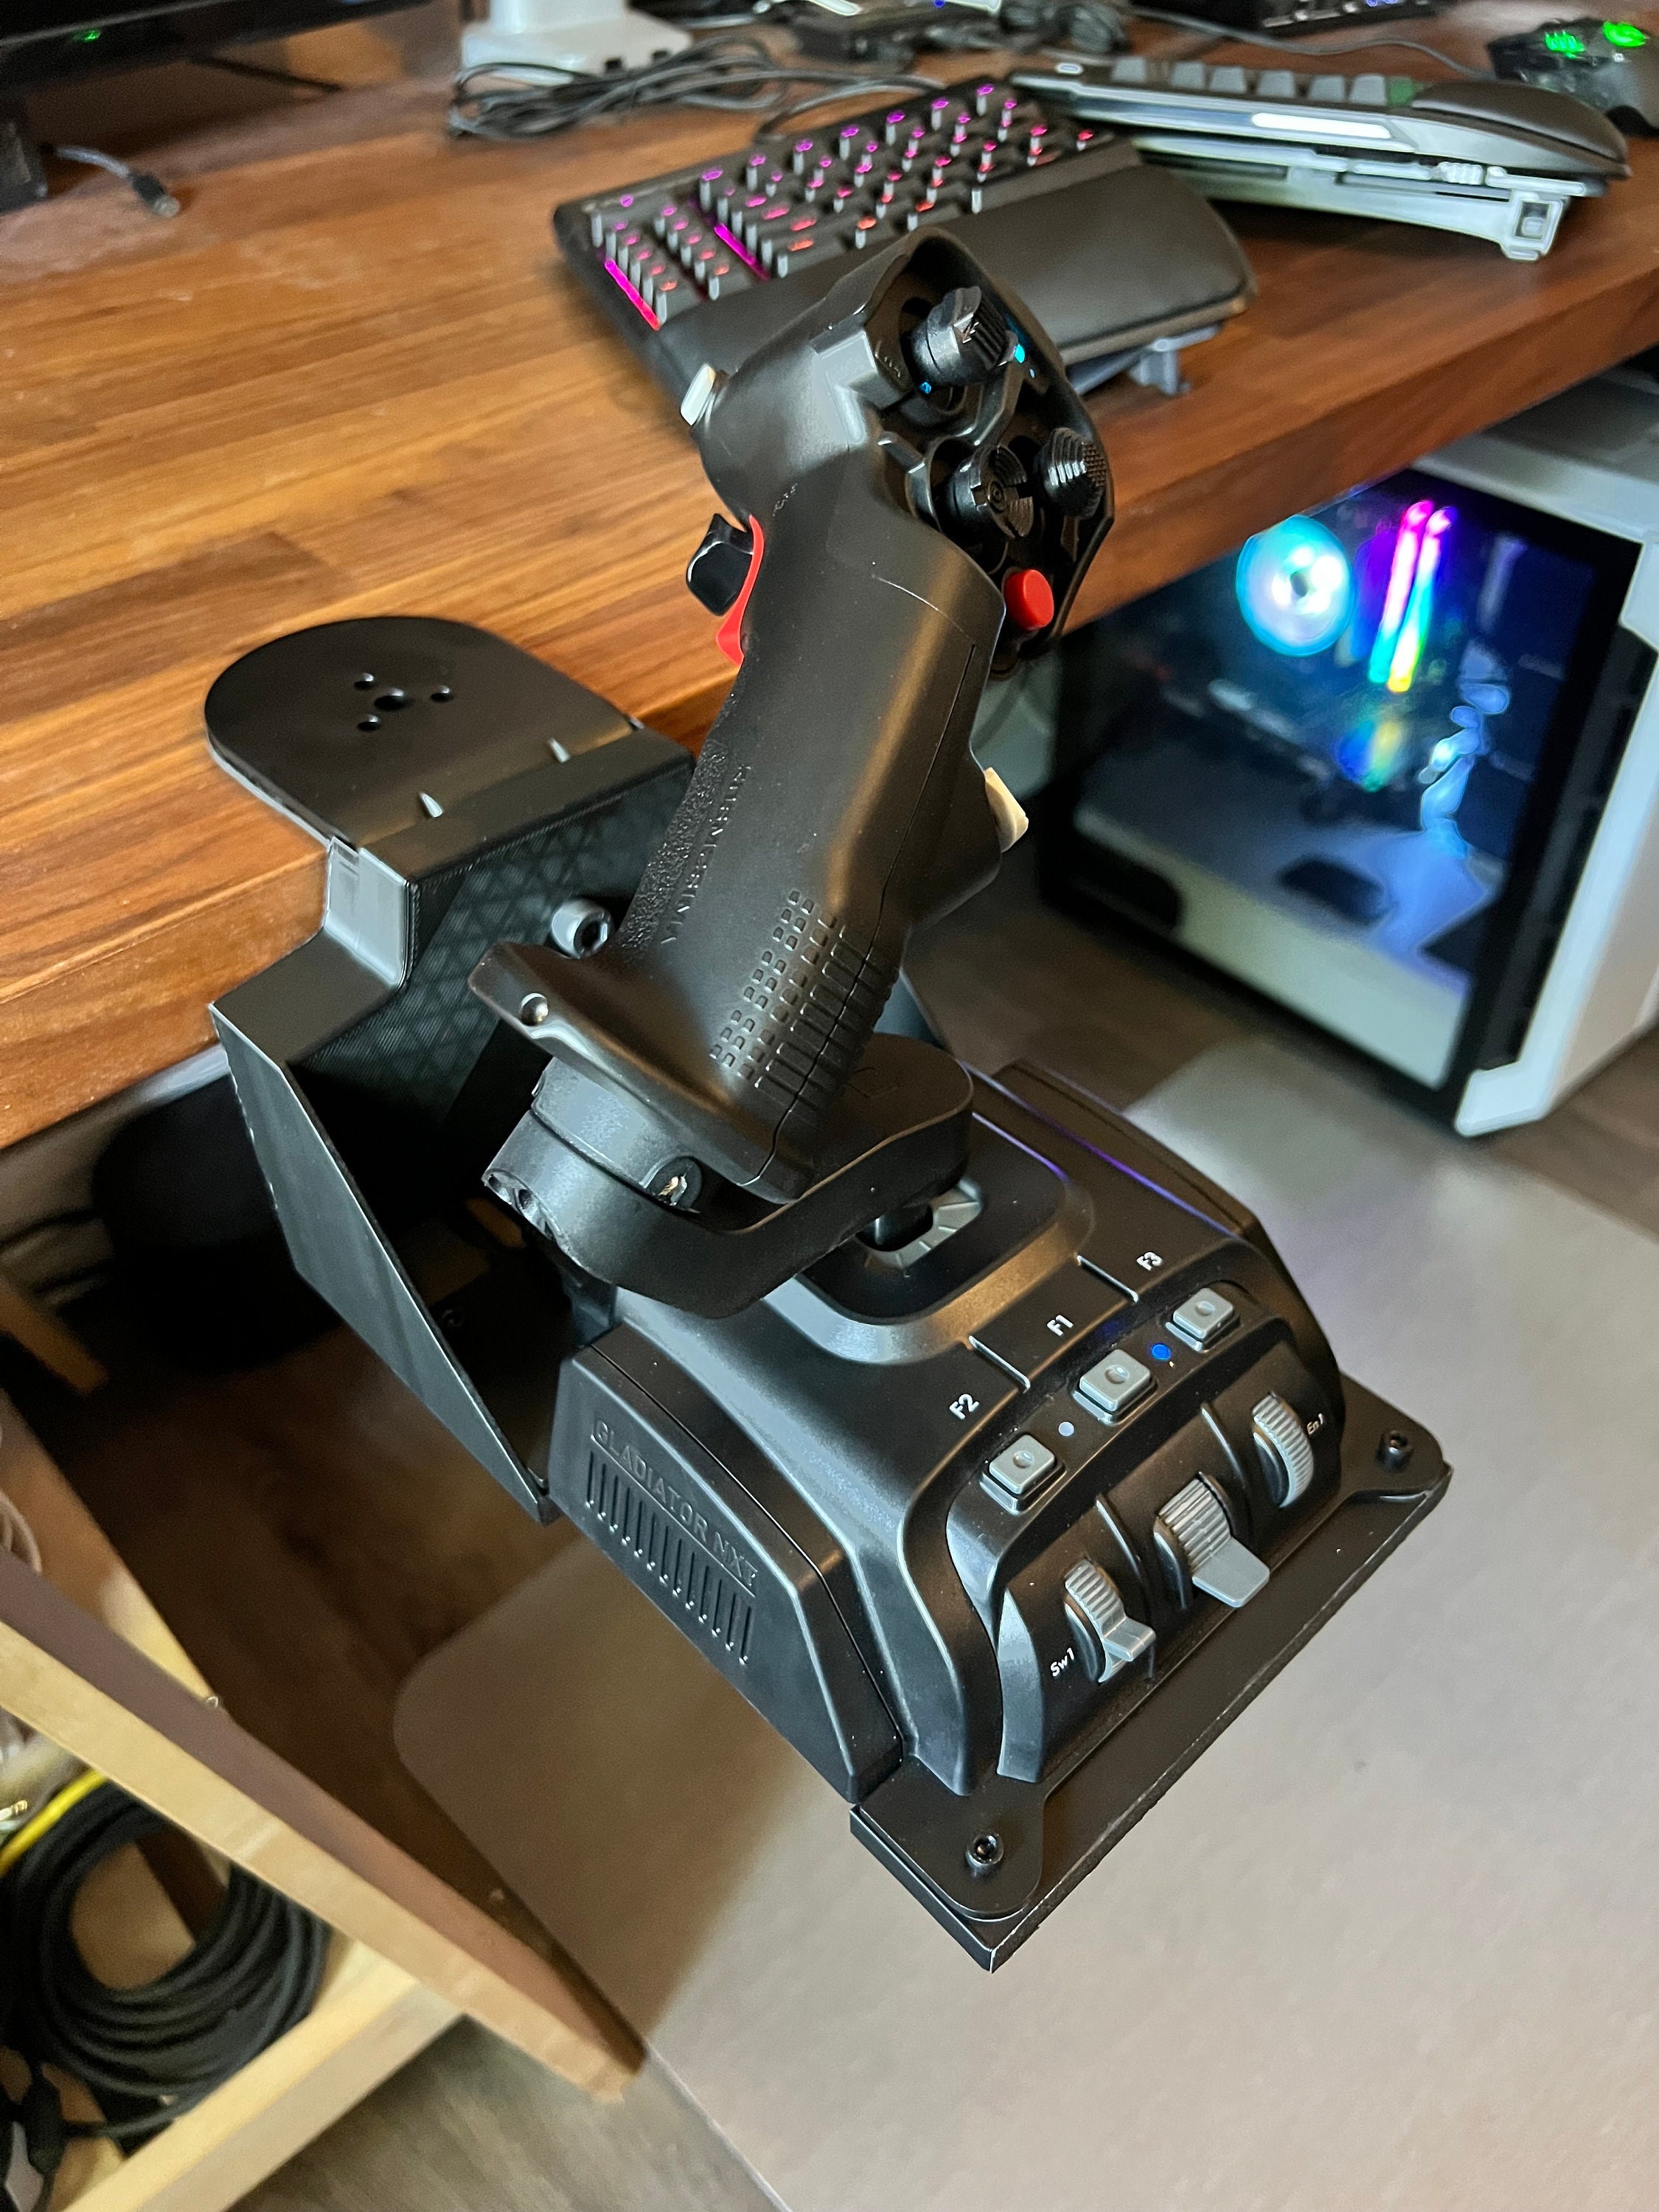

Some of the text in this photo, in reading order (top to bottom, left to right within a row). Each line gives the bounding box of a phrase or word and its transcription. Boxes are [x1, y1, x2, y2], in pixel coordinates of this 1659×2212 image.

[1136, 1251, 1162, 1270] F3
[1046, 1314, 1074, 1337] F1
[949, 1394, 980, 1420] F2
[1307, 1413, 1324, 1435] En1
[597, 1420, 759, 1586] GLADIATOR NXT
[1050, 1647, 1074, 1677] Sw1
